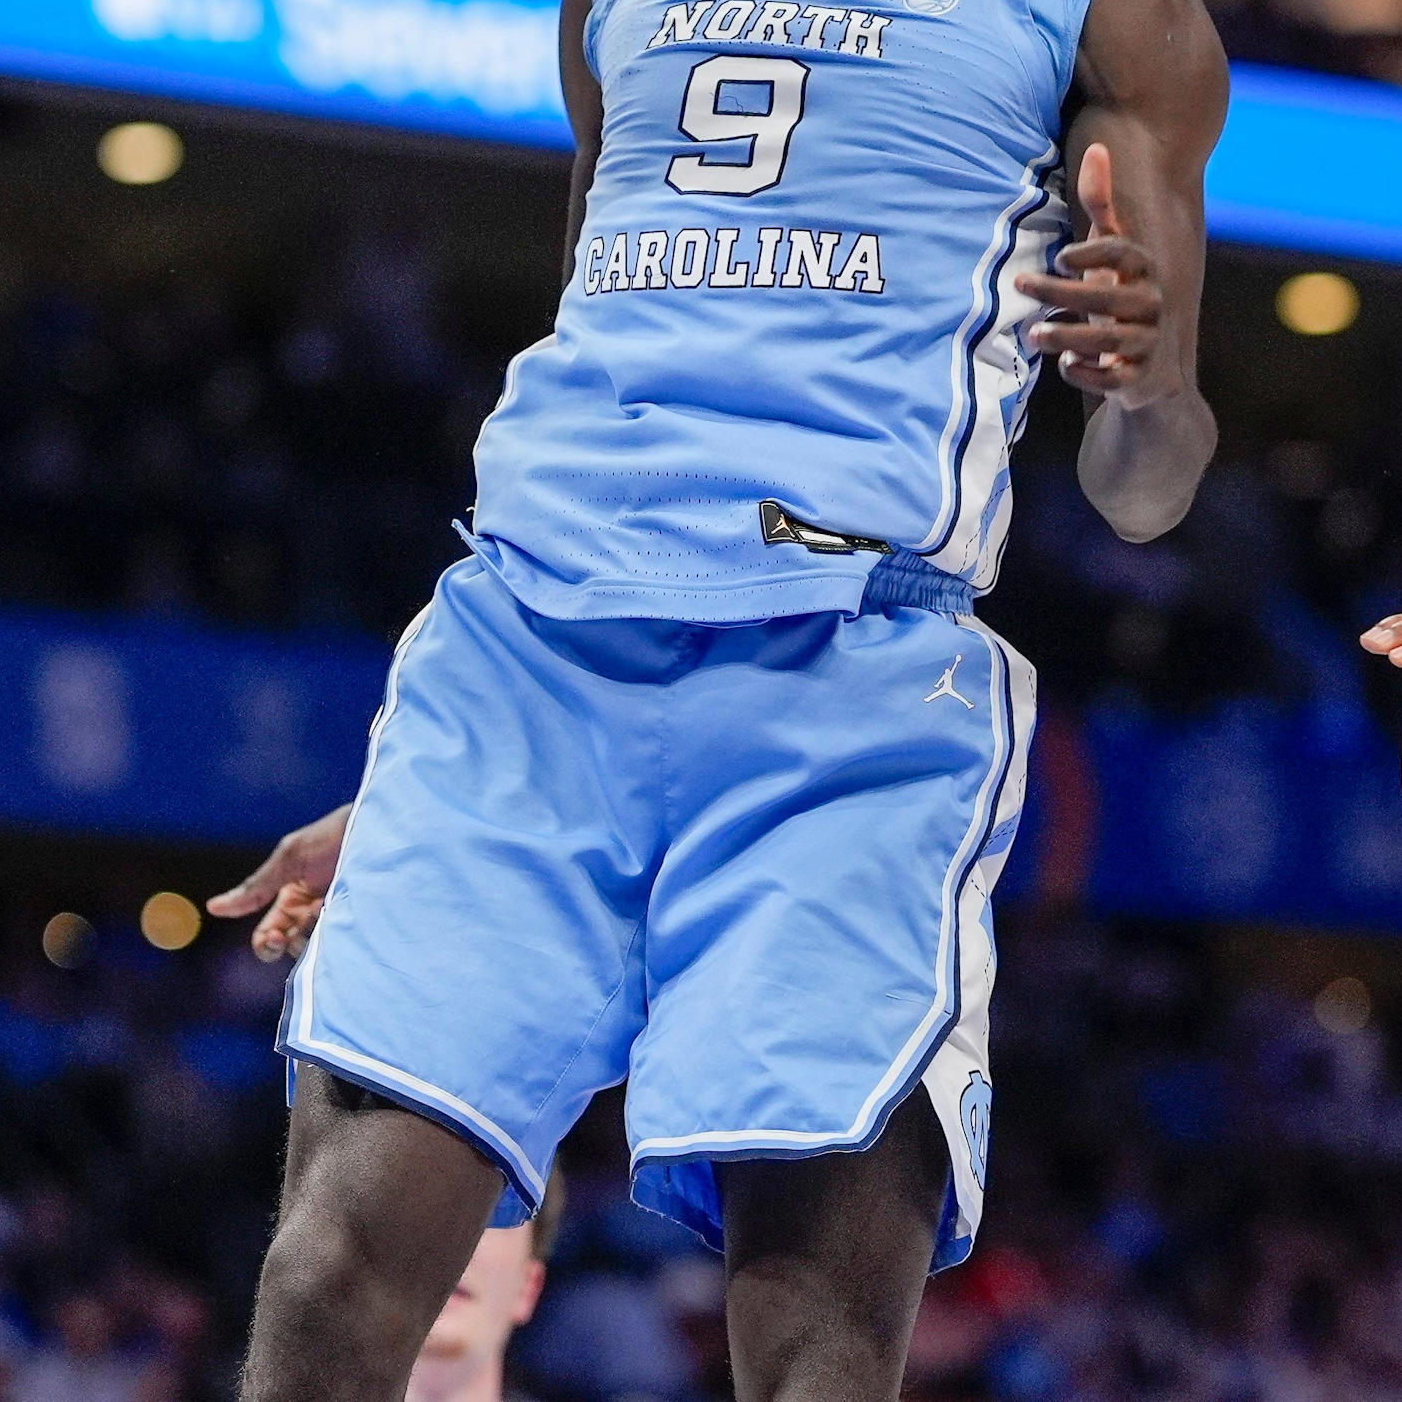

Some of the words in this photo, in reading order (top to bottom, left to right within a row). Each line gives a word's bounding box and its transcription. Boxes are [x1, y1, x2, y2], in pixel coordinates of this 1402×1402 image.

[646, 0, 893, 59] NORTH
[664, 52, 812, 198] 9
[583, 227, 887, 295] CAROLINA
